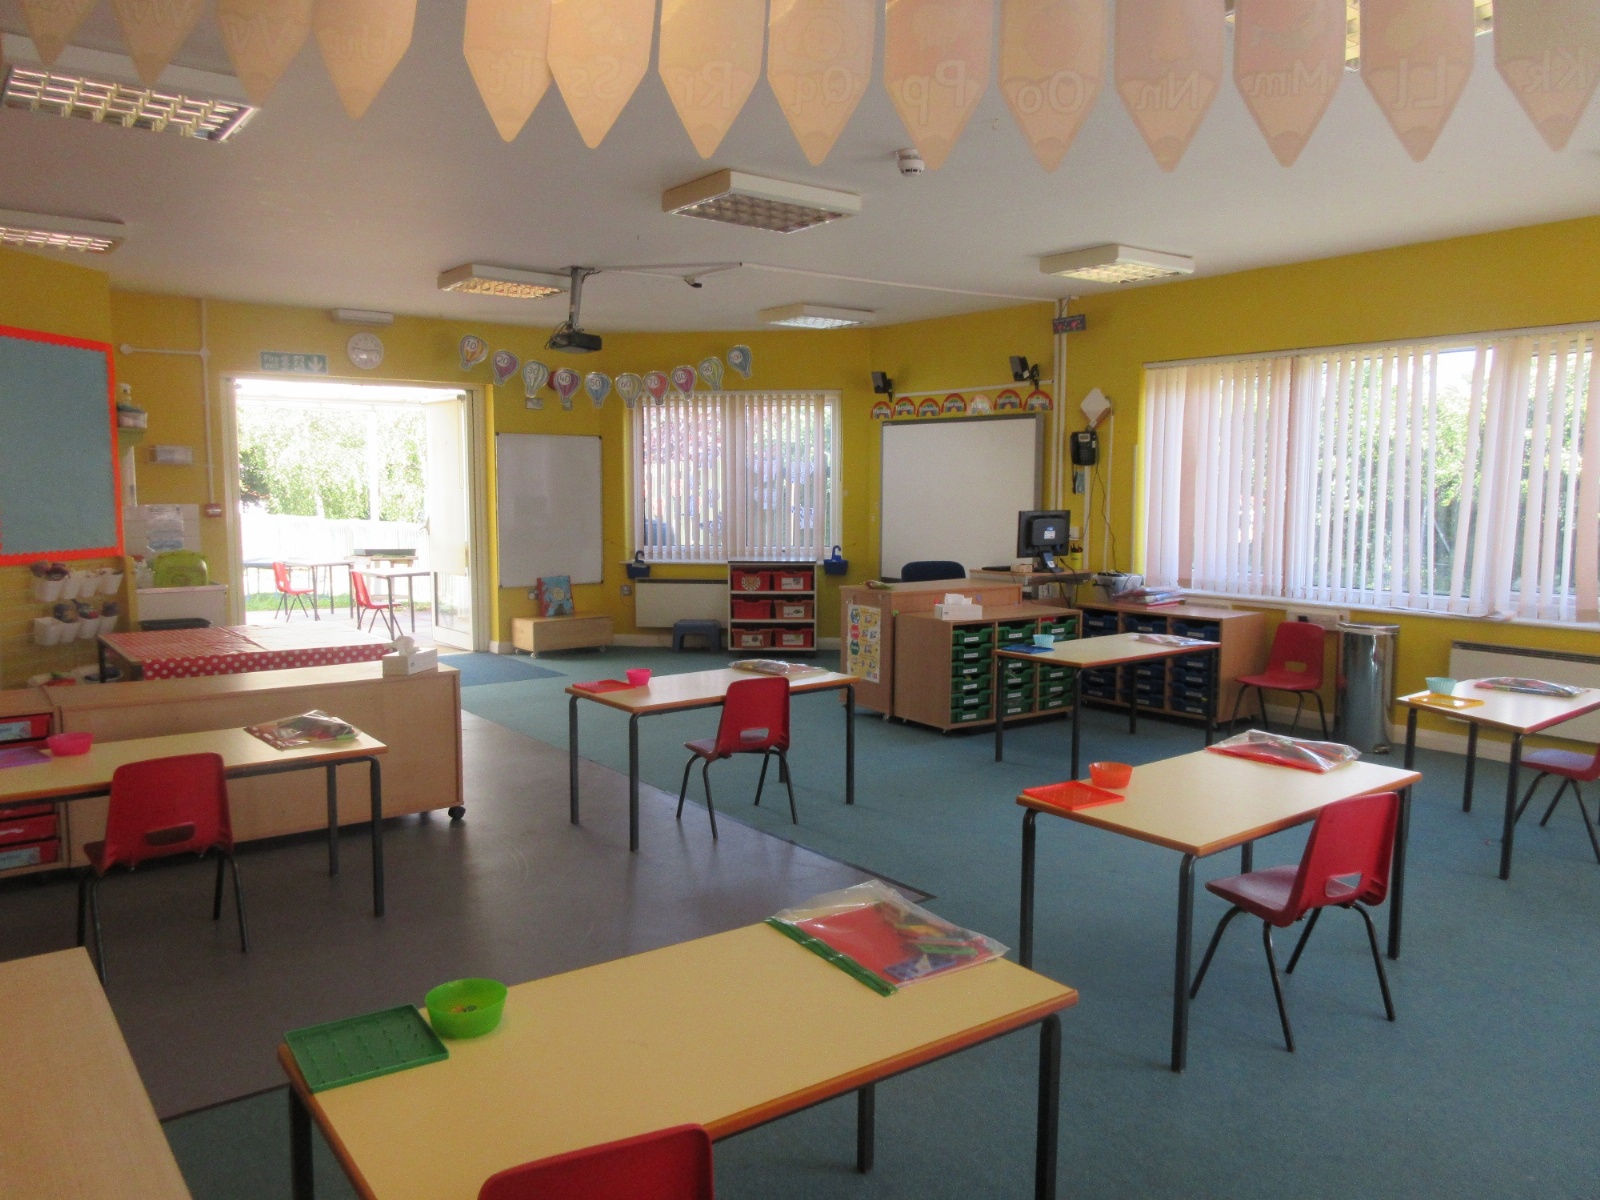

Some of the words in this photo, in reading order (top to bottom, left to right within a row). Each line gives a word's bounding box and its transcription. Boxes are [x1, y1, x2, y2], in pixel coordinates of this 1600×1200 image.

[466, 340, 477, 350] 10
[498, 355, 509, 365] 20
[528, 366, 539, 376] 30
[702, 364, 713, 373] 90
[559, 374, 571, 383] 40
[675, 372, 687, 382] 80
[590, 379, 601, 388] 50
[621, 380, 632, 389] 60
[648, 379, 659, 387] 70
